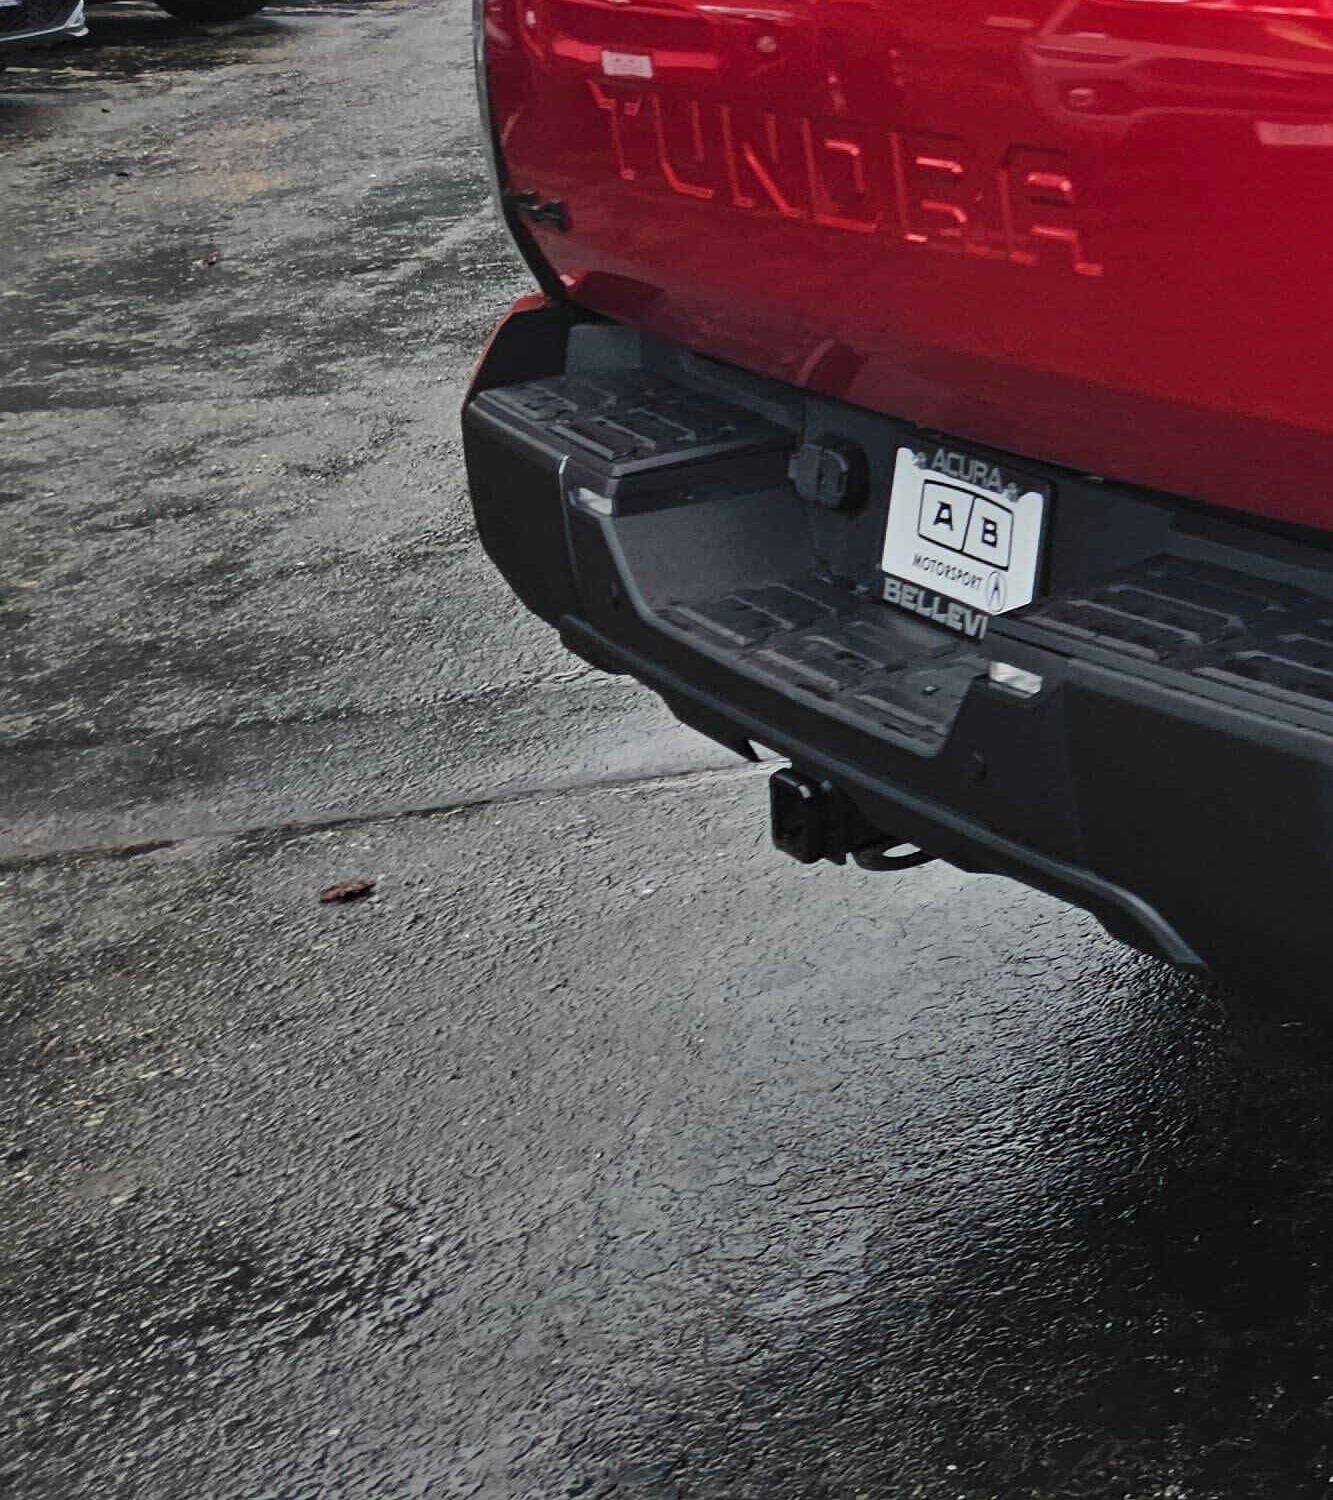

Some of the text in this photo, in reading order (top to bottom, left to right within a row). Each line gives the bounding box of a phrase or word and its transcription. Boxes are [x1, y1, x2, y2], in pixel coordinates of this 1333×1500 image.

[587, 80, 1105, 277] TUNDRA
[931, 448, 1003, 494] ACURA
[932, 500, 999, 549] A B
[912, 553, 984, 592] MOTORSPORT
